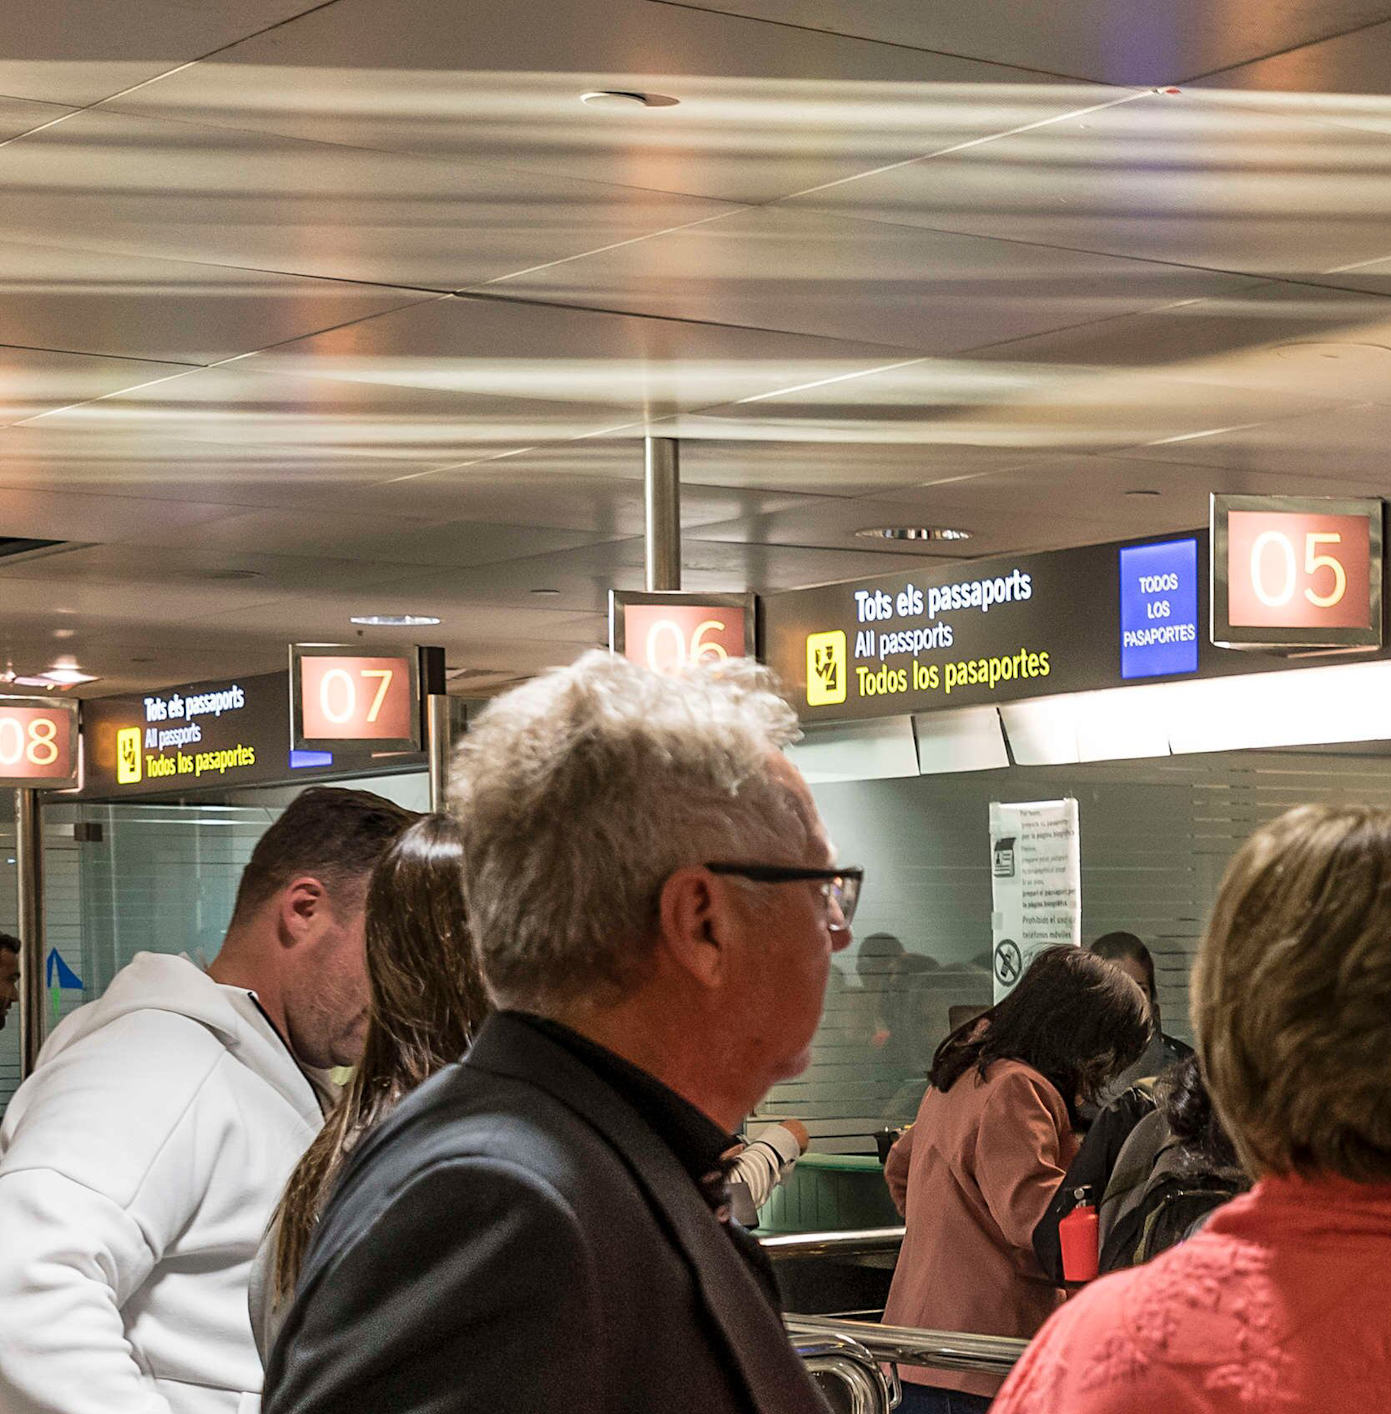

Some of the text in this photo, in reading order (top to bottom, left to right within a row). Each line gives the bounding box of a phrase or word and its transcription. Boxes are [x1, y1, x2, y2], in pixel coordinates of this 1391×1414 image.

[1139, 573, 1178, 593] TODOS
[1250, 531, 1347, 607] 05
[854, 569, 1032, 622] Tots els passaports
[1147, 600, 1170, 619] LOS
[646, 620, 728, 677] 06
[854, 621, 954, 661] All passports
[1123, 624, 1196, 647] PASAPORTES
[855, 648, 1051, 697] Todos los pasaportes
[143, 684, 245, 722] Tots els passaports
[319, 668, 393, 723] 07
[0, 717, 58, 766] 08
[145, 722, 202, 751] All passports
[145, 743, 255, 778] Todos los pasaportes
